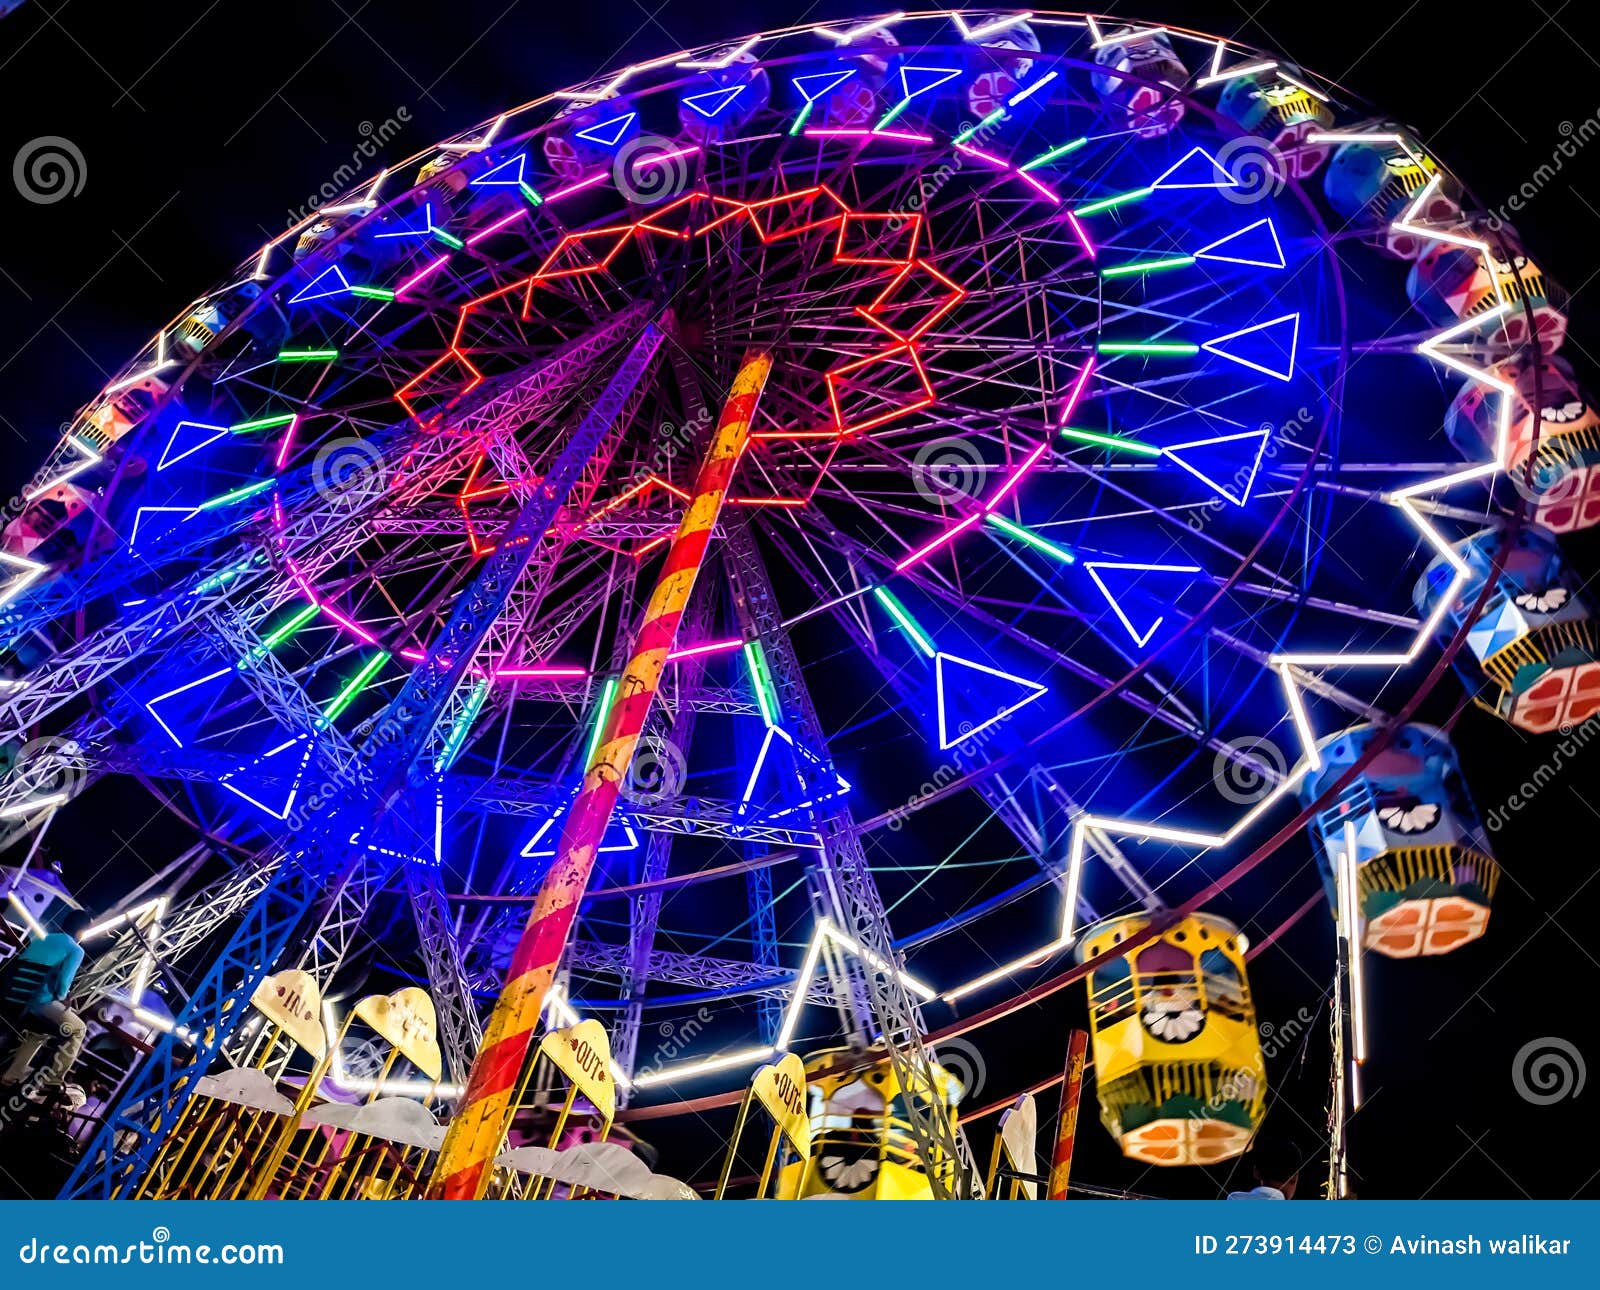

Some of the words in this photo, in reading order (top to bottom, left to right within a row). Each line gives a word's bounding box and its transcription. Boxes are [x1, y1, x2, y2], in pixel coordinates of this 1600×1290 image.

[283, 989, 307, 1018] IN
[576, 1041, 603, 1081] OUT
[778, 1073, 802, 1114] OUT
